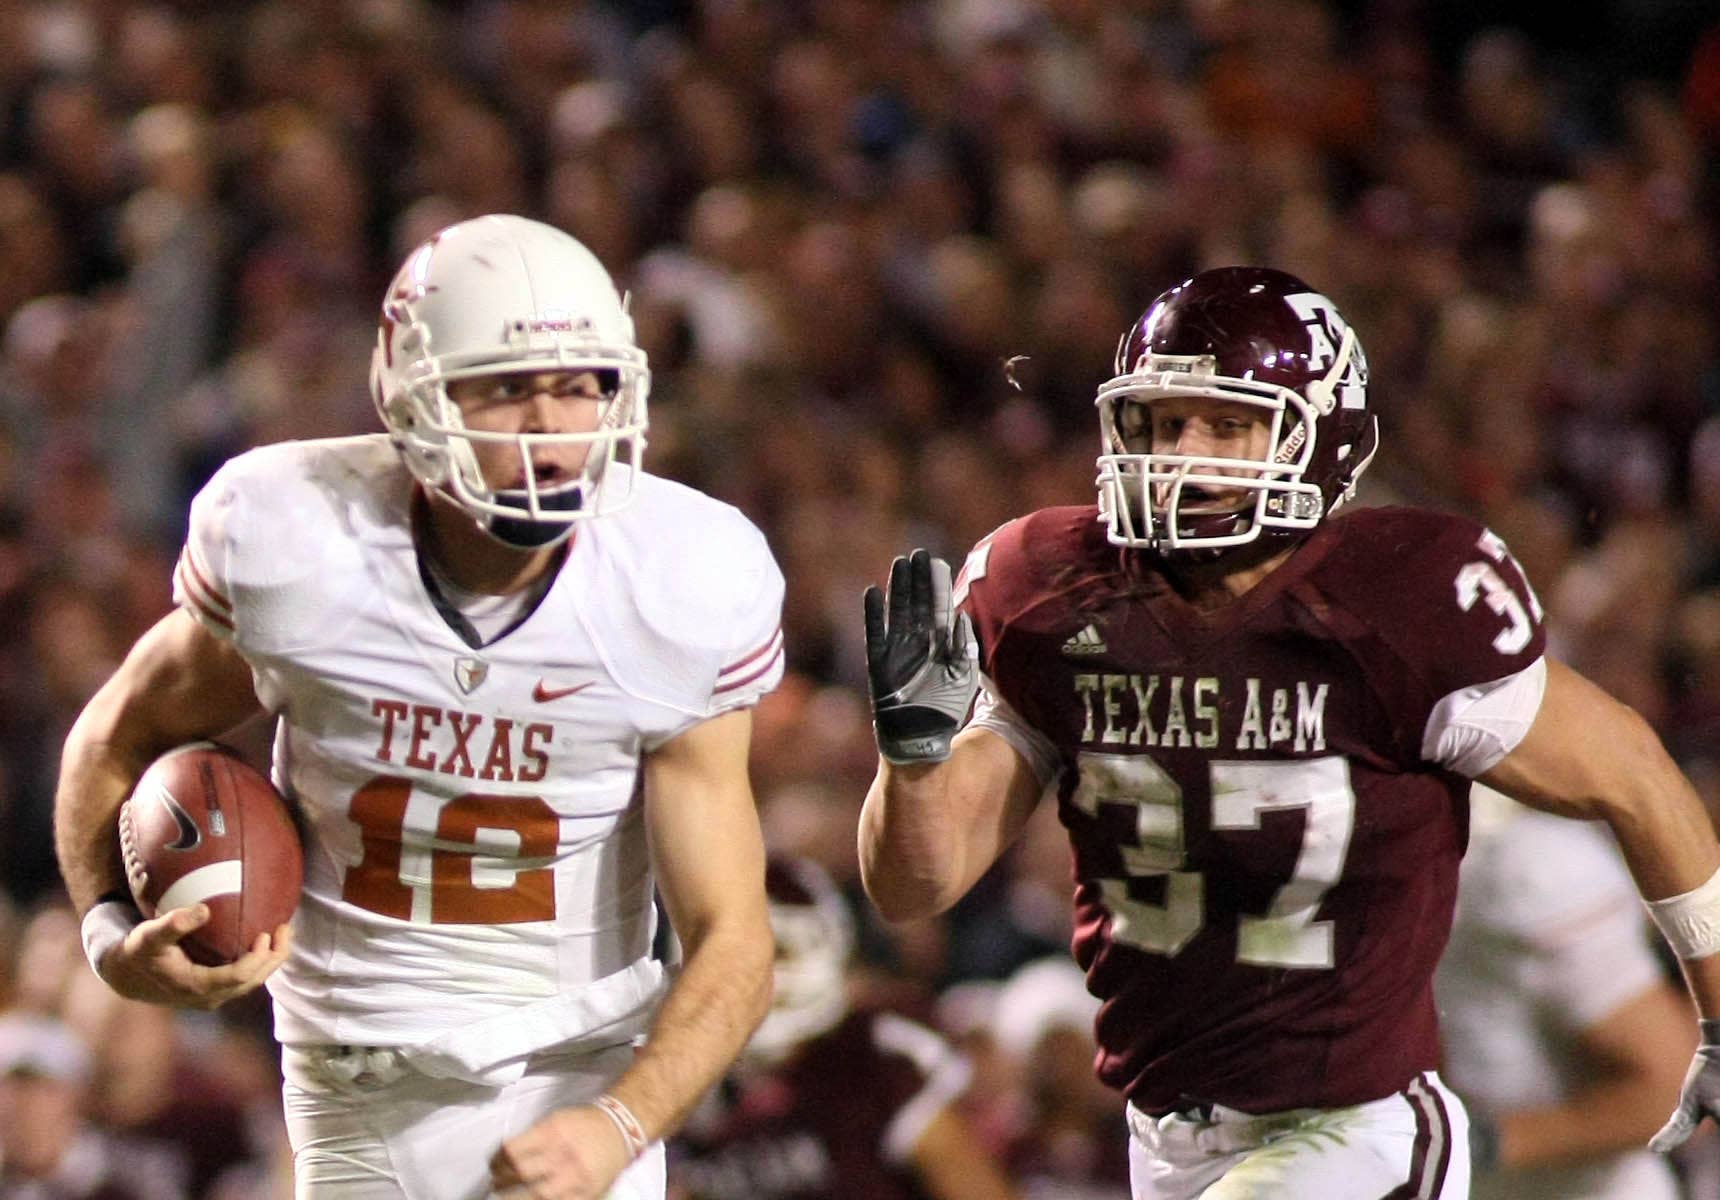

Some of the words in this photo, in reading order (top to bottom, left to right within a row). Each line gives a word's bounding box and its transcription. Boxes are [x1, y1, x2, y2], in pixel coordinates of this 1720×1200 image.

[371, 698, 554, 783] TEXAS
[1074, 674, 1220, 749] TEXAS
[1236, 678, 1330, 752] A&M
[342, 775, 560, 925] 12
[1071, 751, 1356, 969] 37
